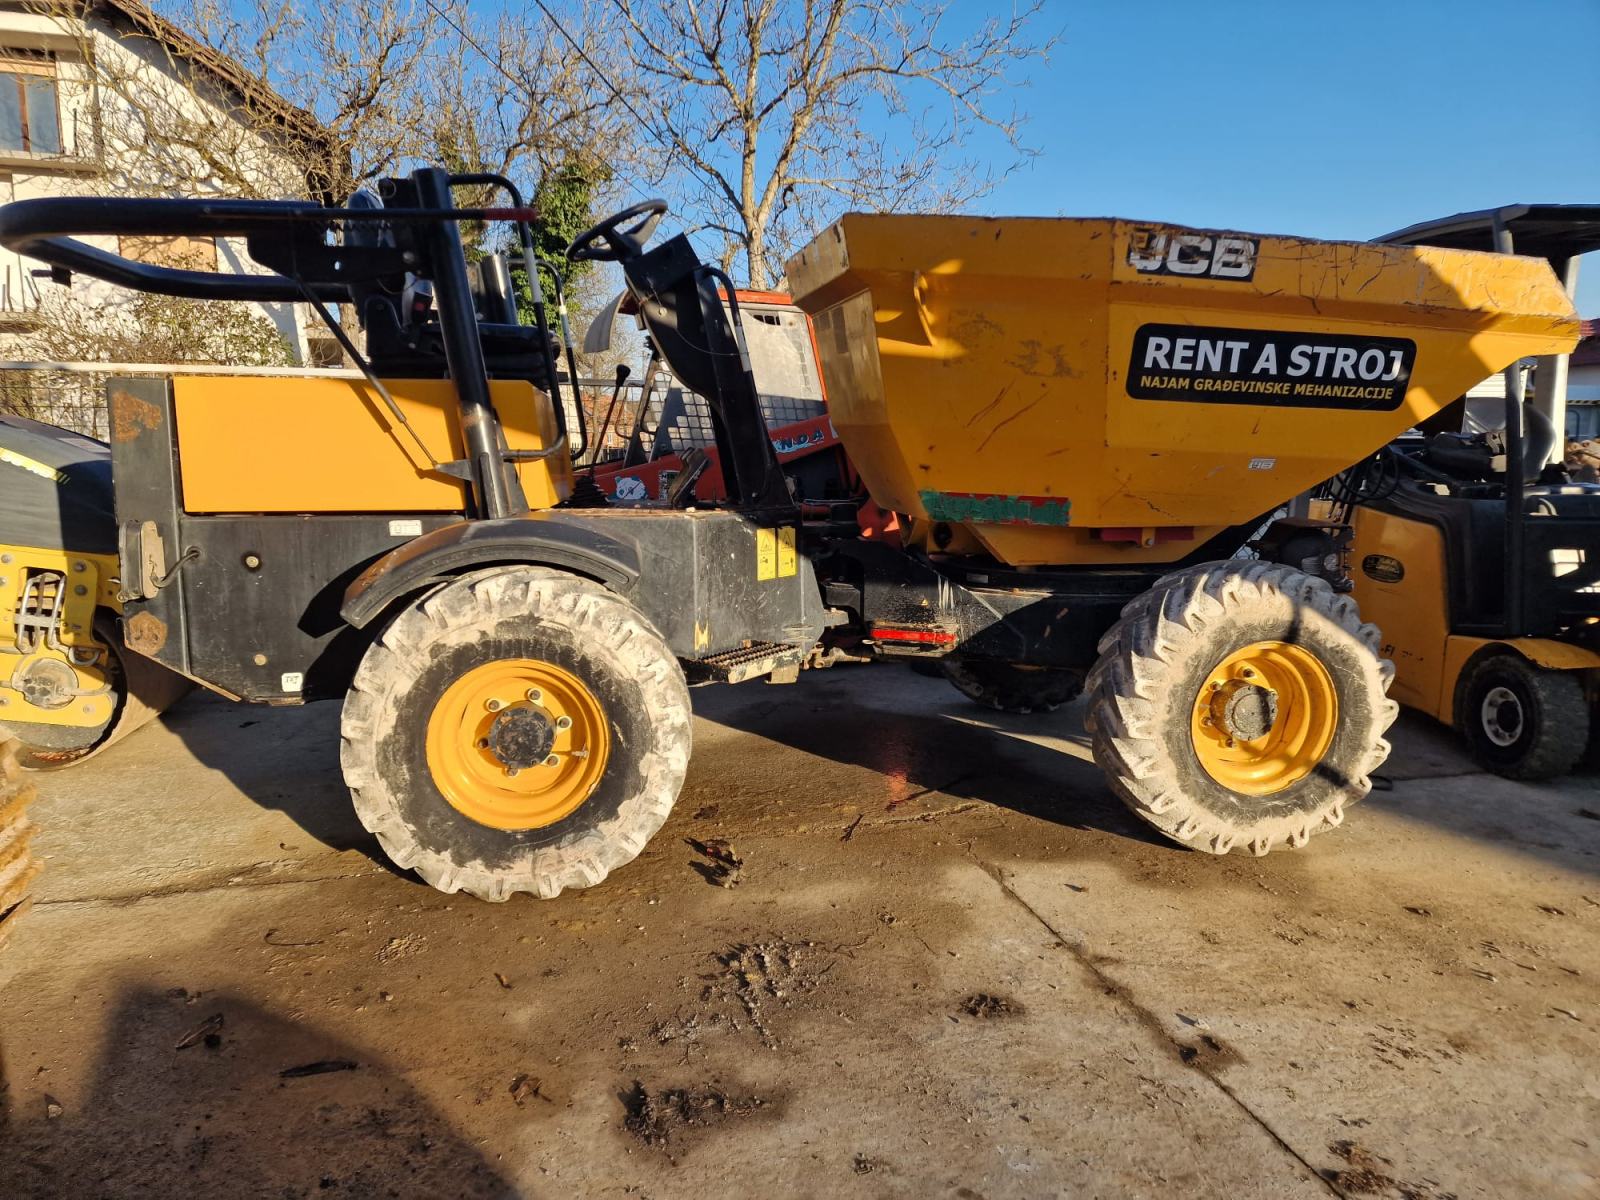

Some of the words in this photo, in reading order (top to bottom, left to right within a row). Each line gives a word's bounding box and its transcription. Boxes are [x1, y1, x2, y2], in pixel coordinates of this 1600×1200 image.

[1129, 232, 1255, 278] JCB
[1143, 336, 1250, 373] RENT
[1251, 343, 1278, 375] A
[1286, 344, 1404, 381] STROJ
[1140, 375, 1190, 390] NAJAM
[1193, 378, 1292, 395] GRAĐEVINSKE
[1293, 383, 1394, 400] MEHANIZACIJE
